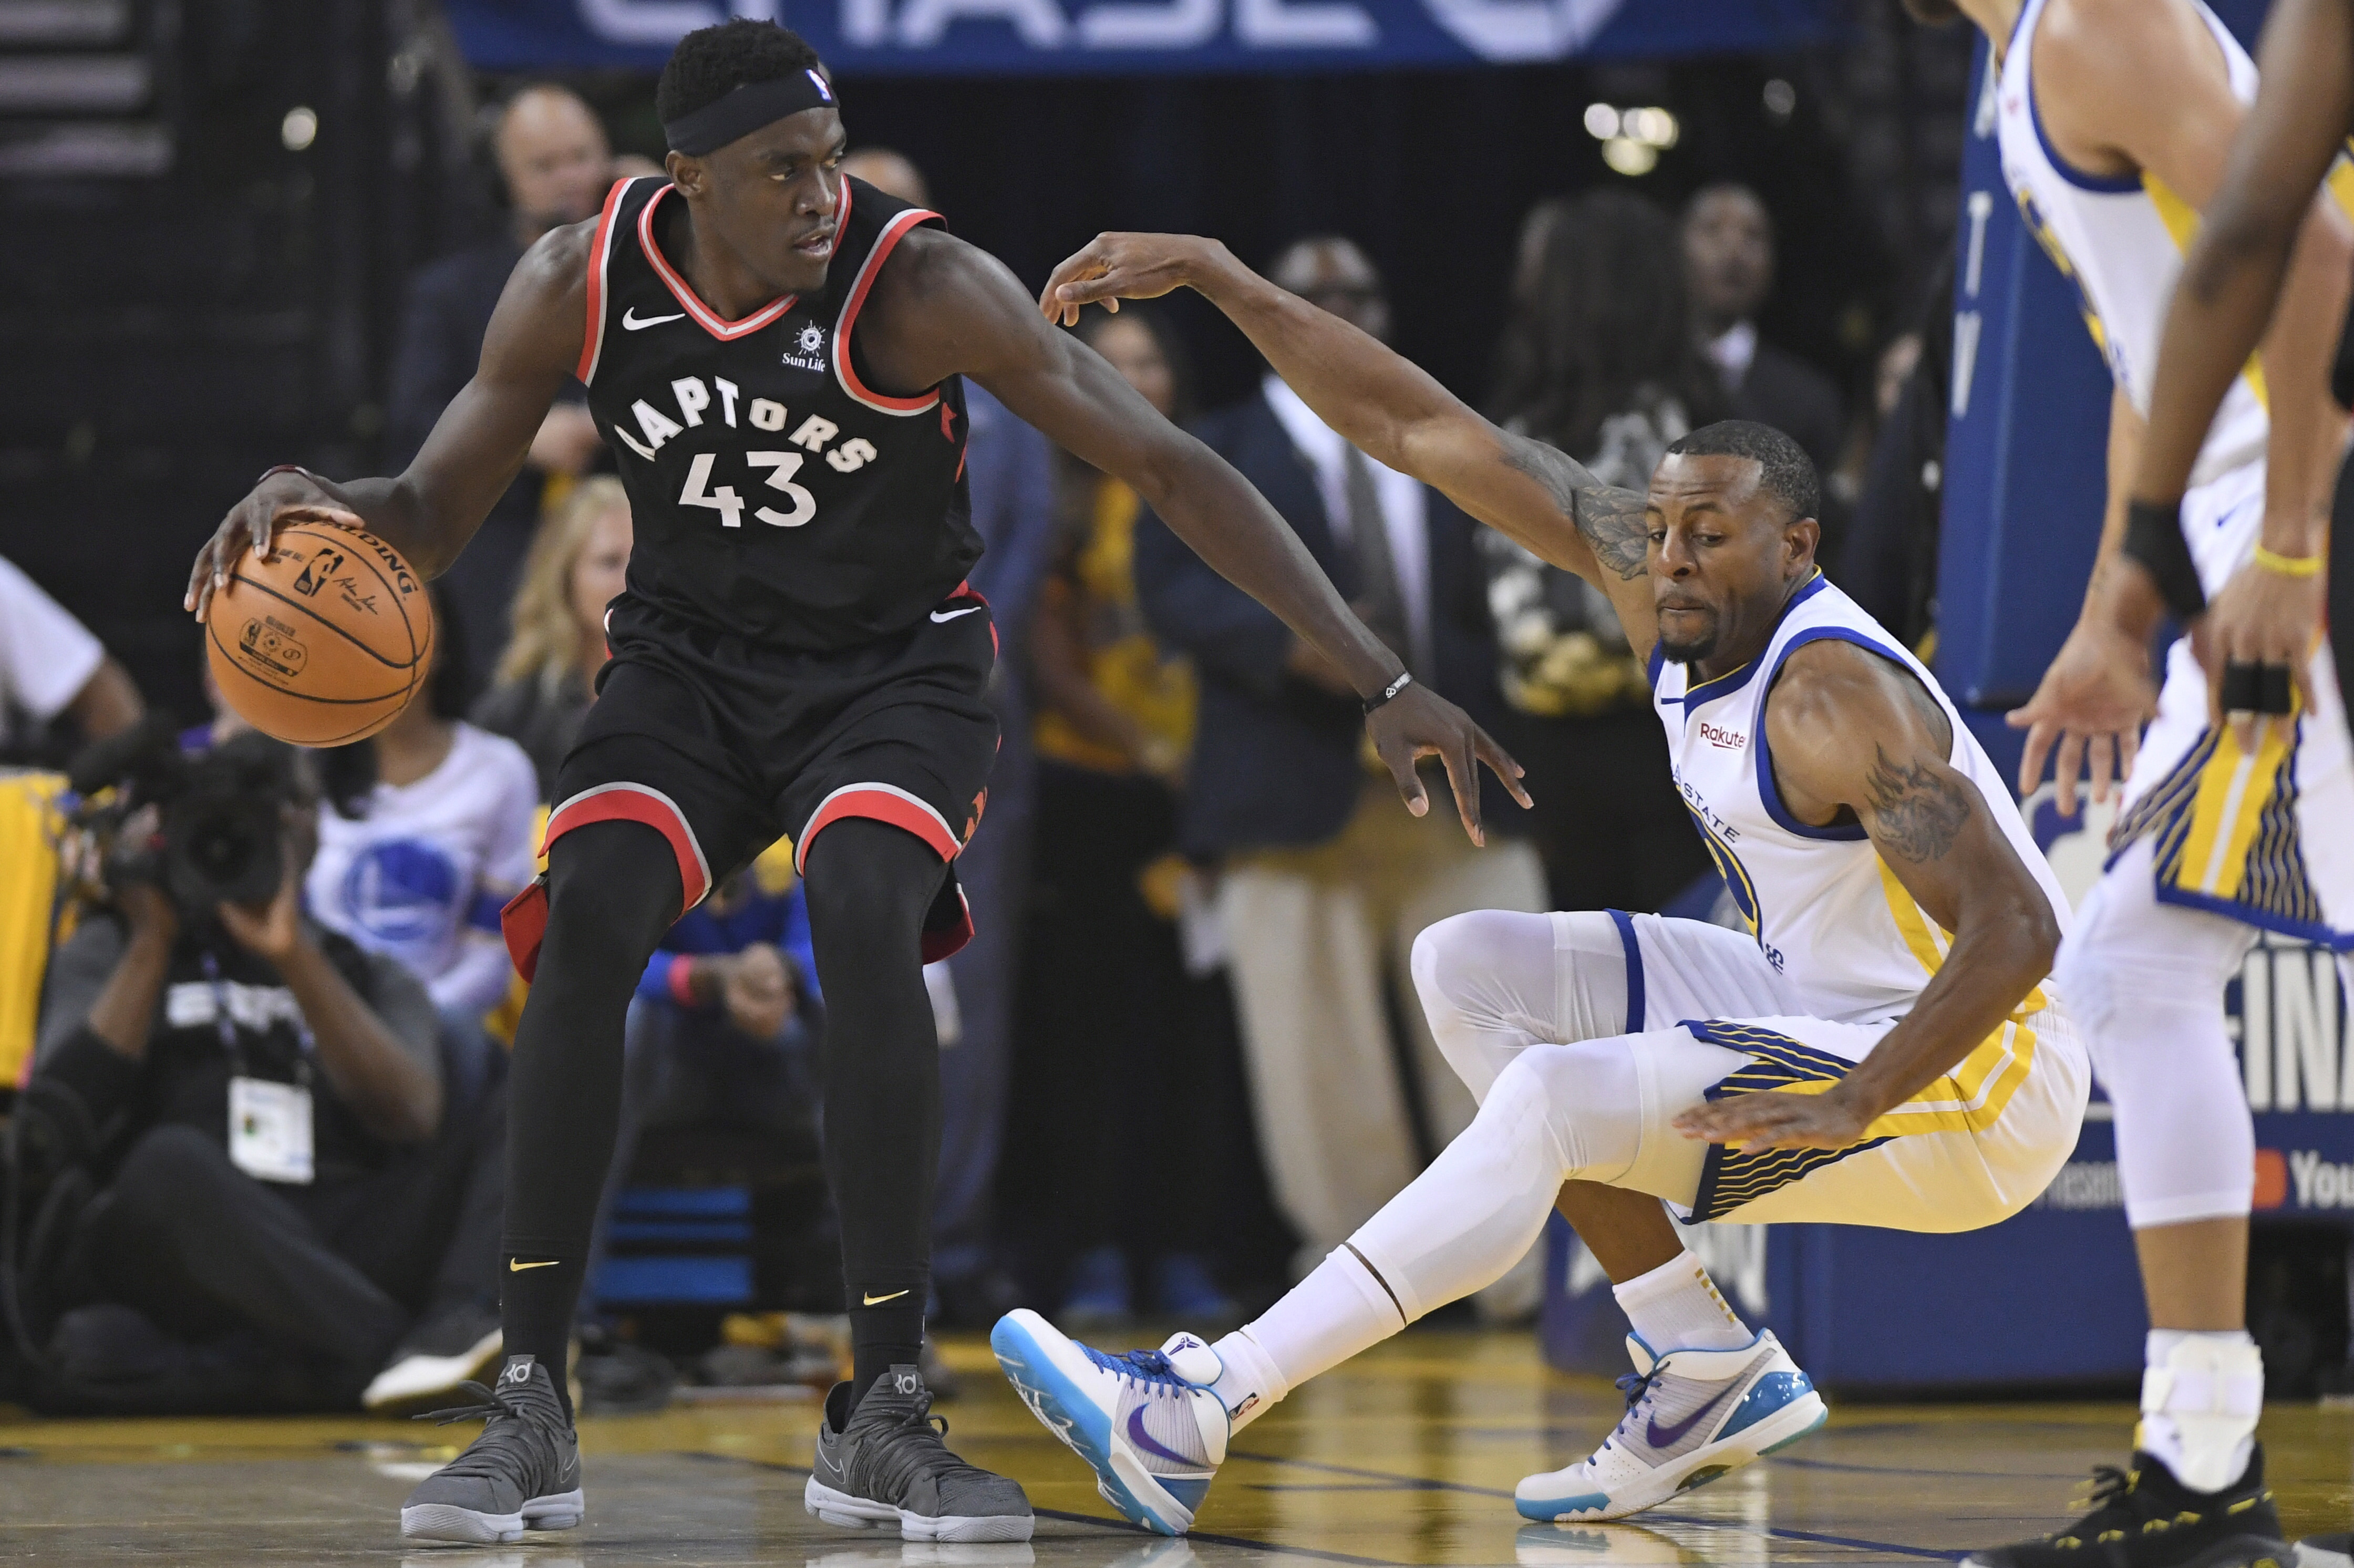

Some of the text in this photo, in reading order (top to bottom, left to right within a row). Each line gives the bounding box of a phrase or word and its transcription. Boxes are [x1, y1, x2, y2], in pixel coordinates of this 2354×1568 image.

[782, 353, 825, 372] Sun Life
[678, 451, 817, 528] 43
[1700, 723, 1746, 748] Rakute
[1684, 782, 1741, 843] STATE
